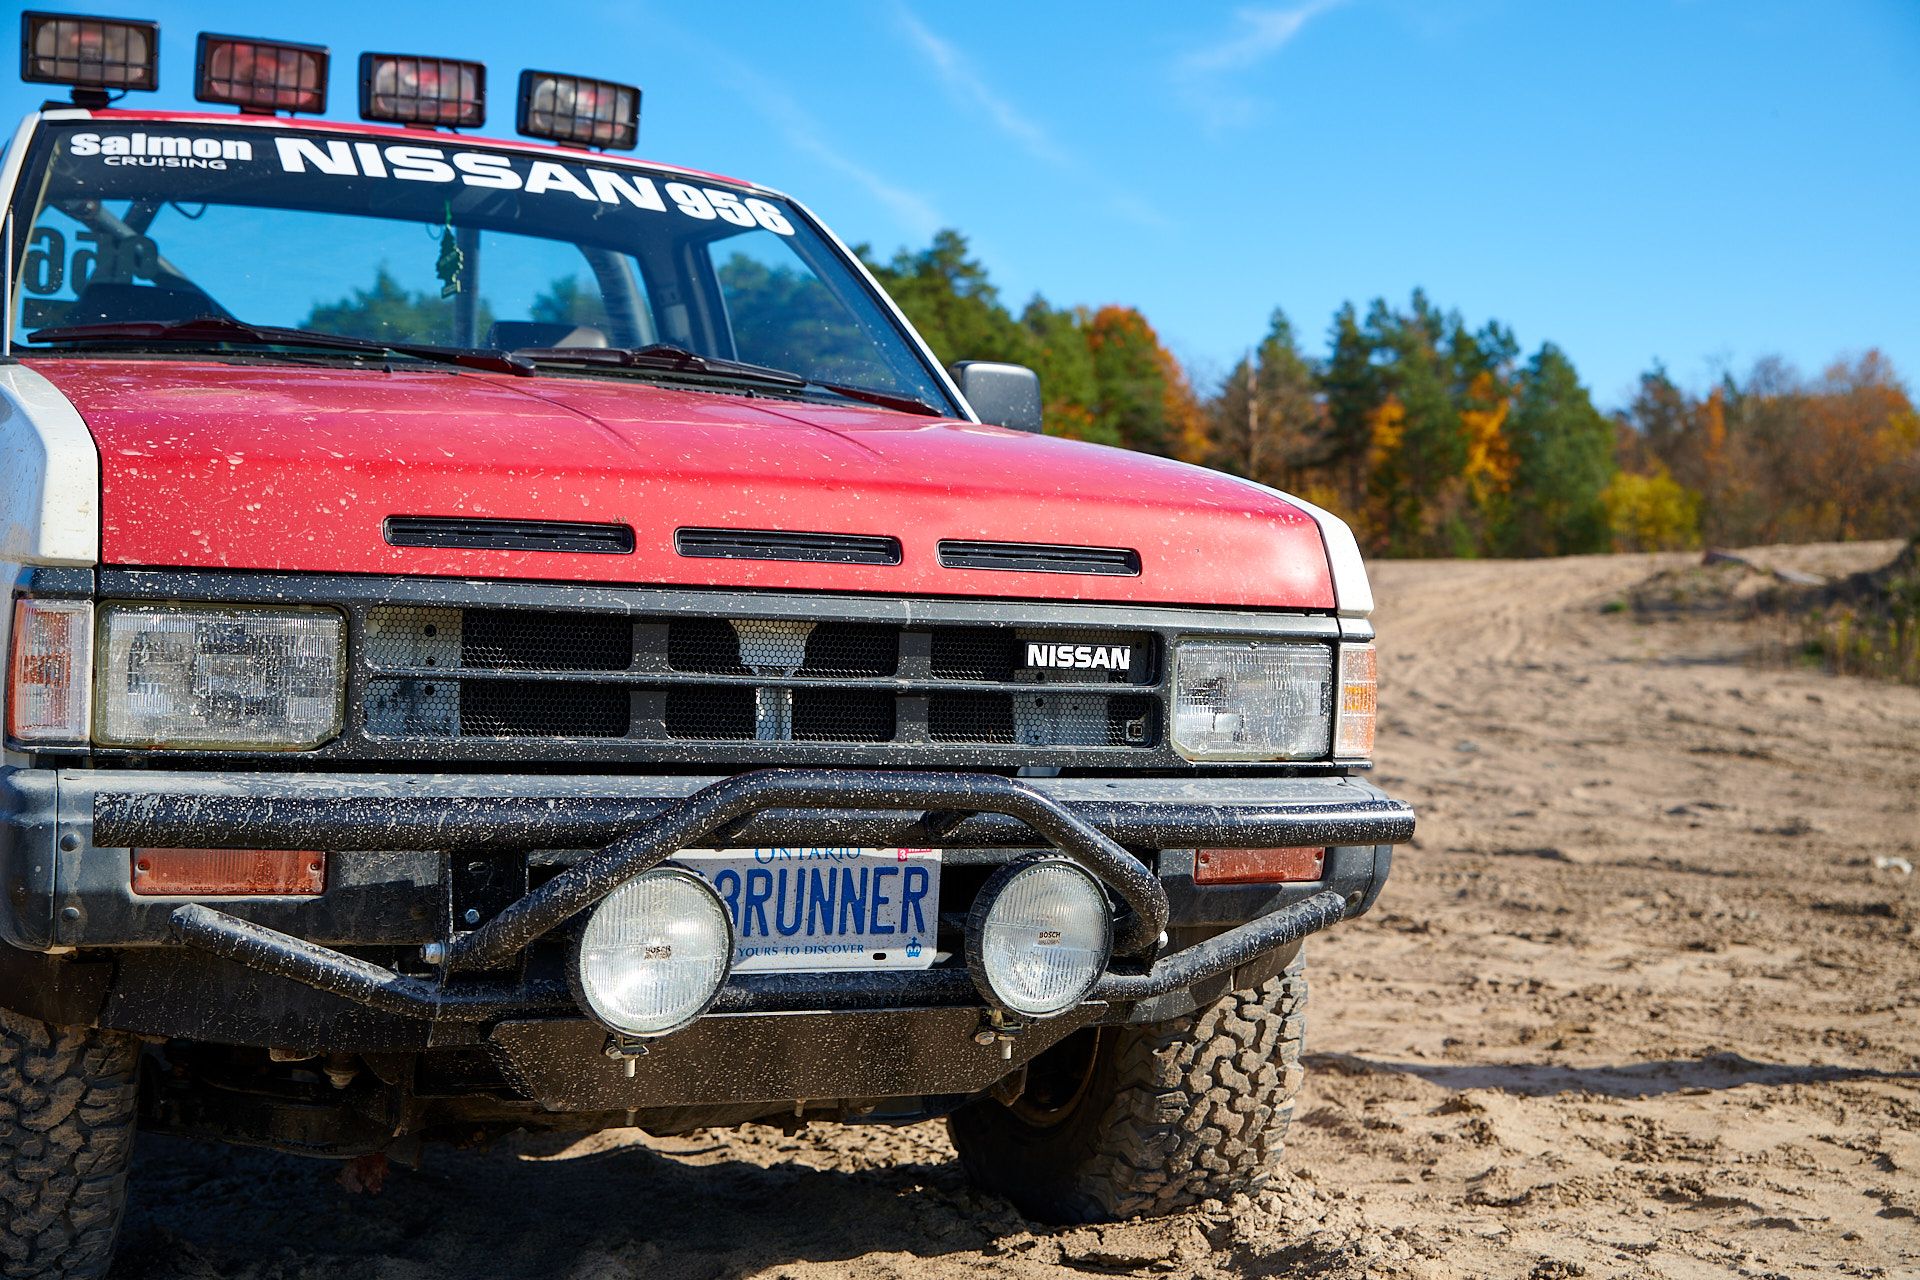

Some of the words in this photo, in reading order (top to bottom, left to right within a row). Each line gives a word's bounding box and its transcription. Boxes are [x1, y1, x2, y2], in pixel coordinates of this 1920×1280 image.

[103, 155, 228, 171] CRUISING
[274, 136, 667, 213] NISSAN
[664, 182, 796, 236] 956
[1027, 644, 1131, 670] NISSAN
[754, 847, 861, 864] ONTARIO
[738, 946, 779, 957] YOURS
[783, 945, 800, 955] TO
[804, 944, 864, 955] DISCOVER
